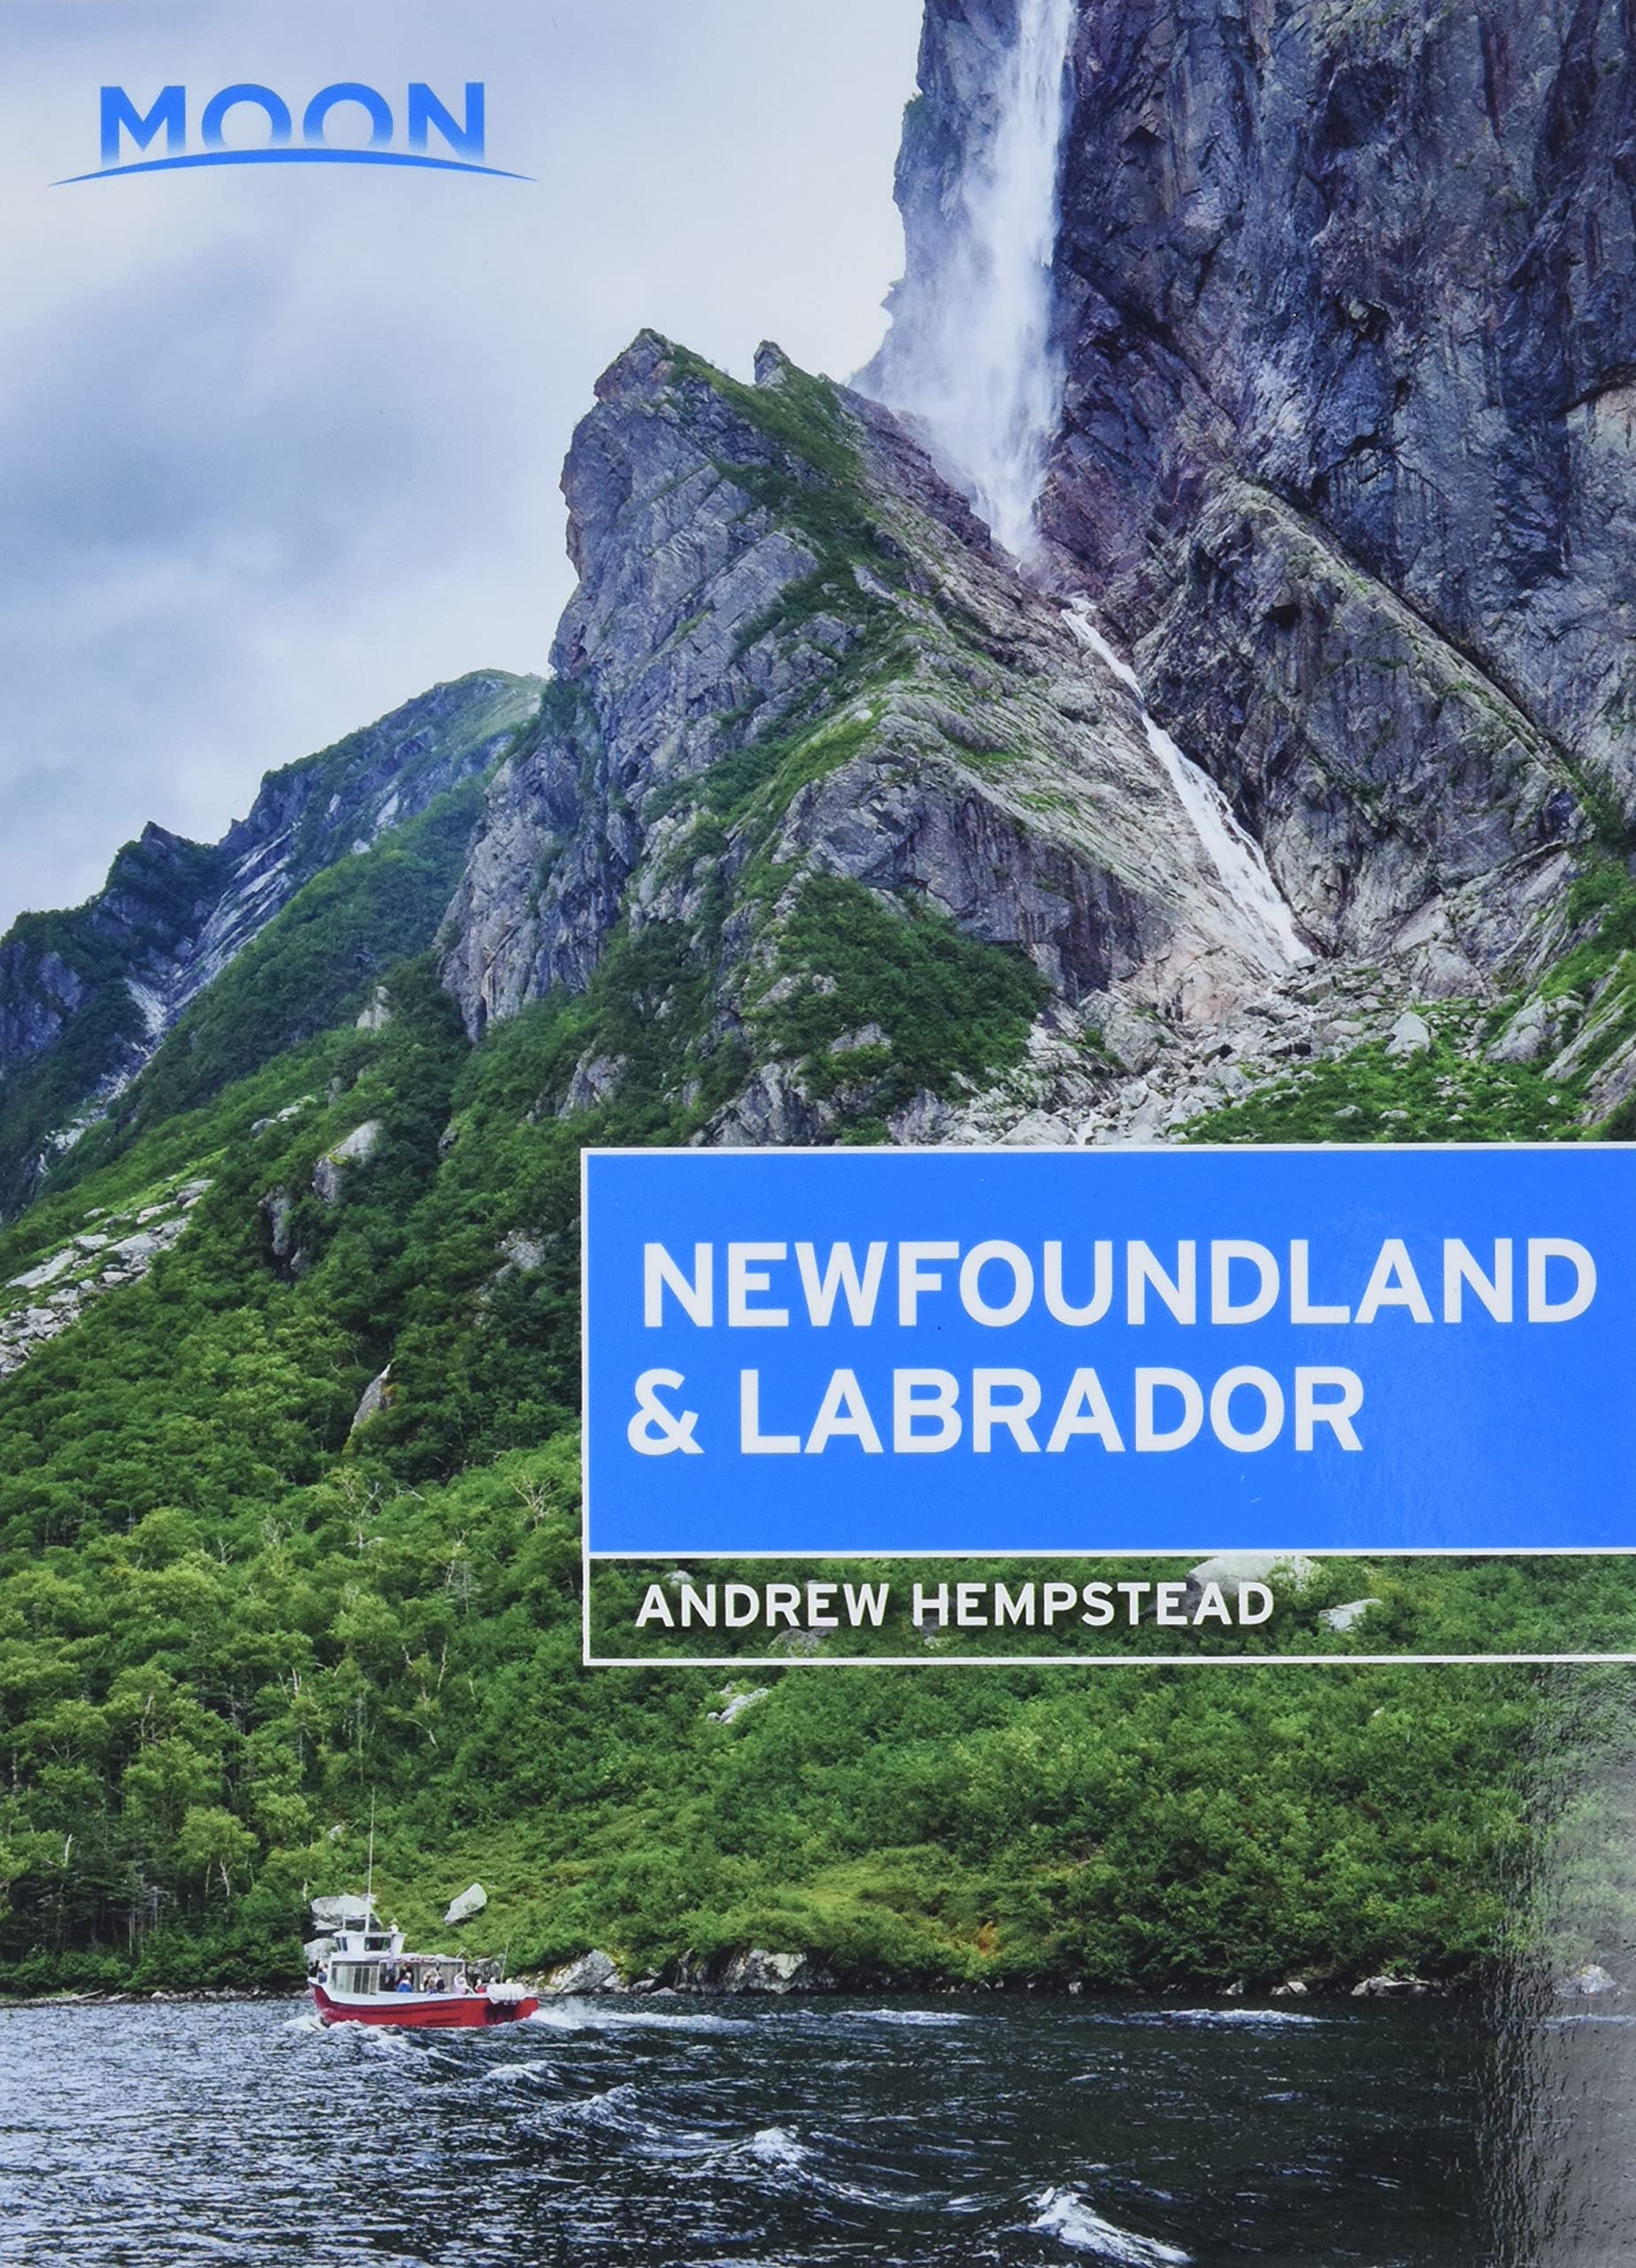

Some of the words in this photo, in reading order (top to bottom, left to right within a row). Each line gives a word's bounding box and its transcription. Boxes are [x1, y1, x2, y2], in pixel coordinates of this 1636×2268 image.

[100, 82, 485, 167] MOON
[644, 1239, 1598, 1328] NEWFOUNDLAND
[627, 1368, 704, 1456] &
[740, 1366, 1364, 1454] LABRADOR
[634, 1583, 890, 1627] ANDREW
[912, 1581, 1275, 1627] HEMPSTEAD
